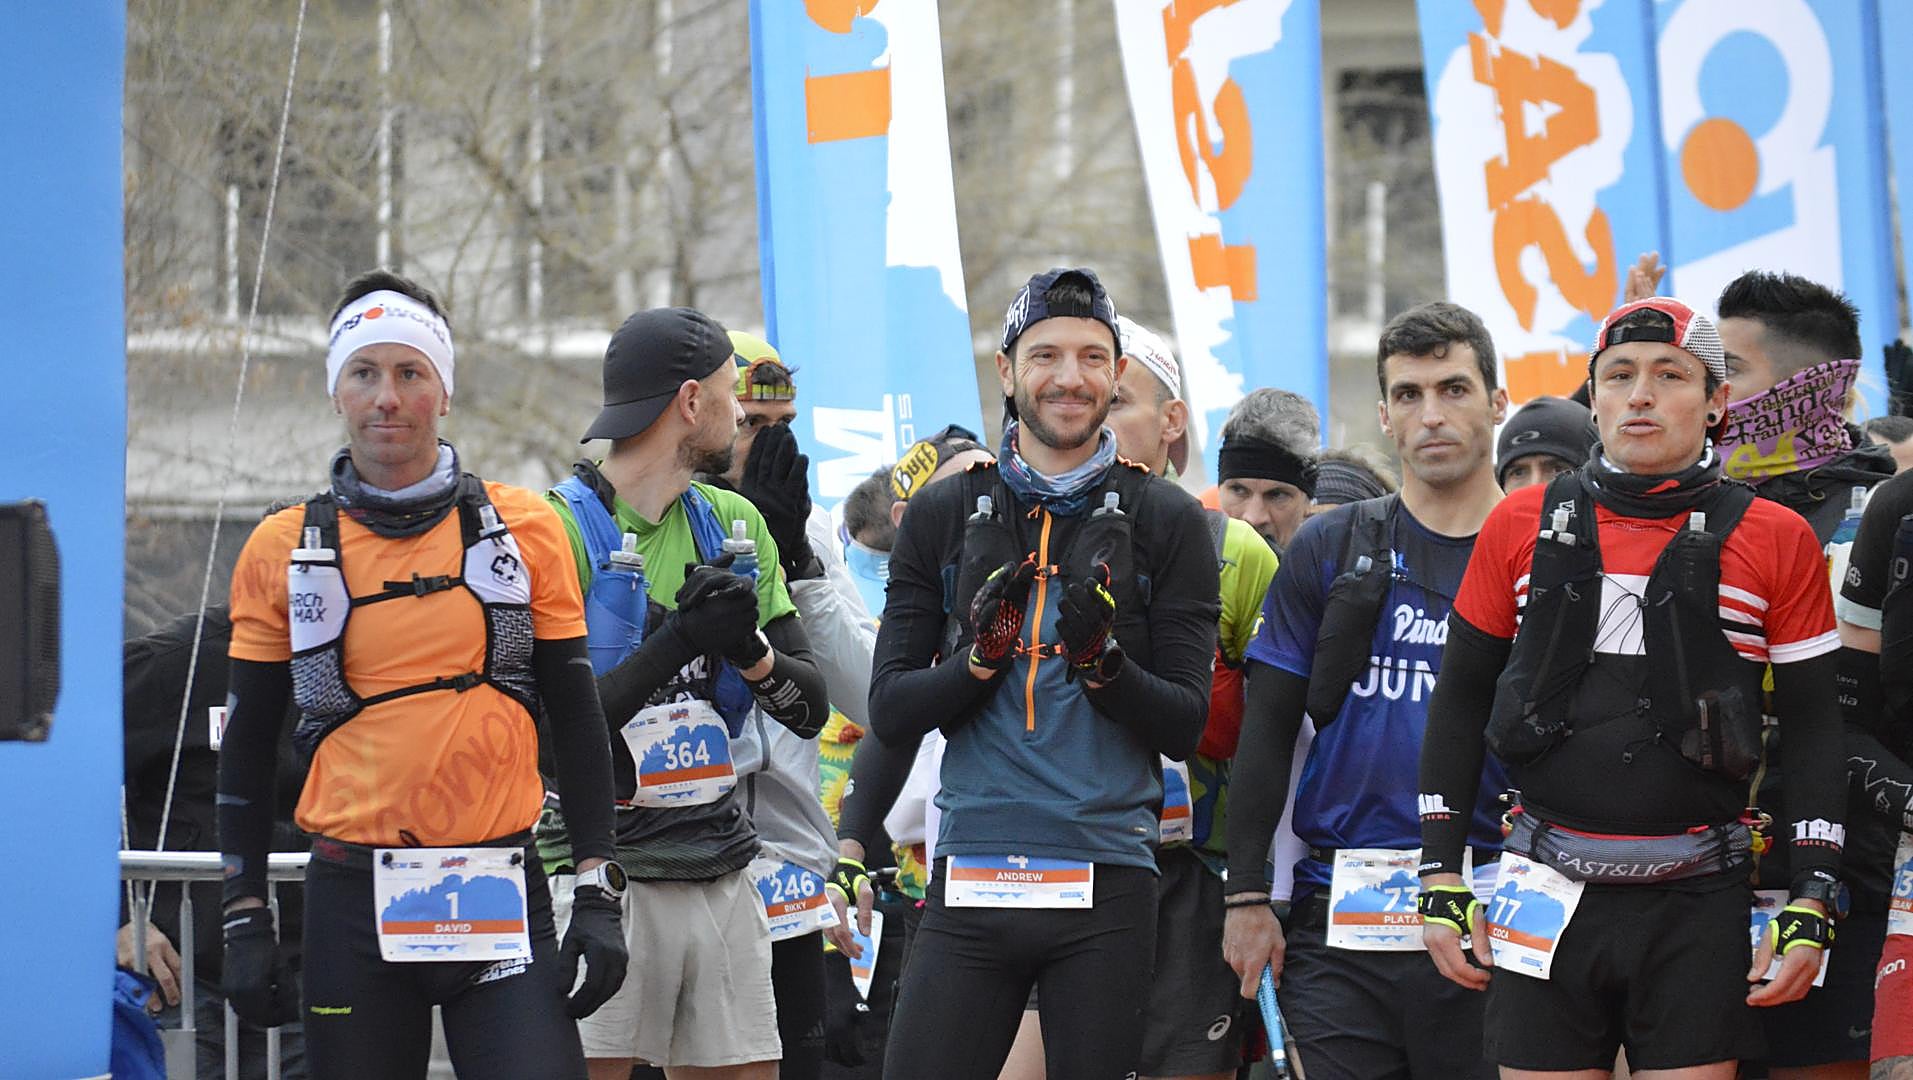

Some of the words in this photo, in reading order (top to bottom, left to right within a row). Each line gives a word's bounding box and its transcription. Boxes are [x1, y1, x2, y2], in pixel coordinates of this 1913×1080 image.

[895, 443, 935, 497] Buff
[662, 739, 711, 770] 364
[769, 870, 816, 904] 246
[996, 871, 1044, 882] ANDREW
[445, 891, 460, 920] 1
[783, 901, 808, 913] RIKKY
[1383, 887, 1420, 913] 73
[1493, 895, 1523, 927] 77
[433, 923, 473, 934] DAVID
[1383, 914, 1420, 925] PLATA
